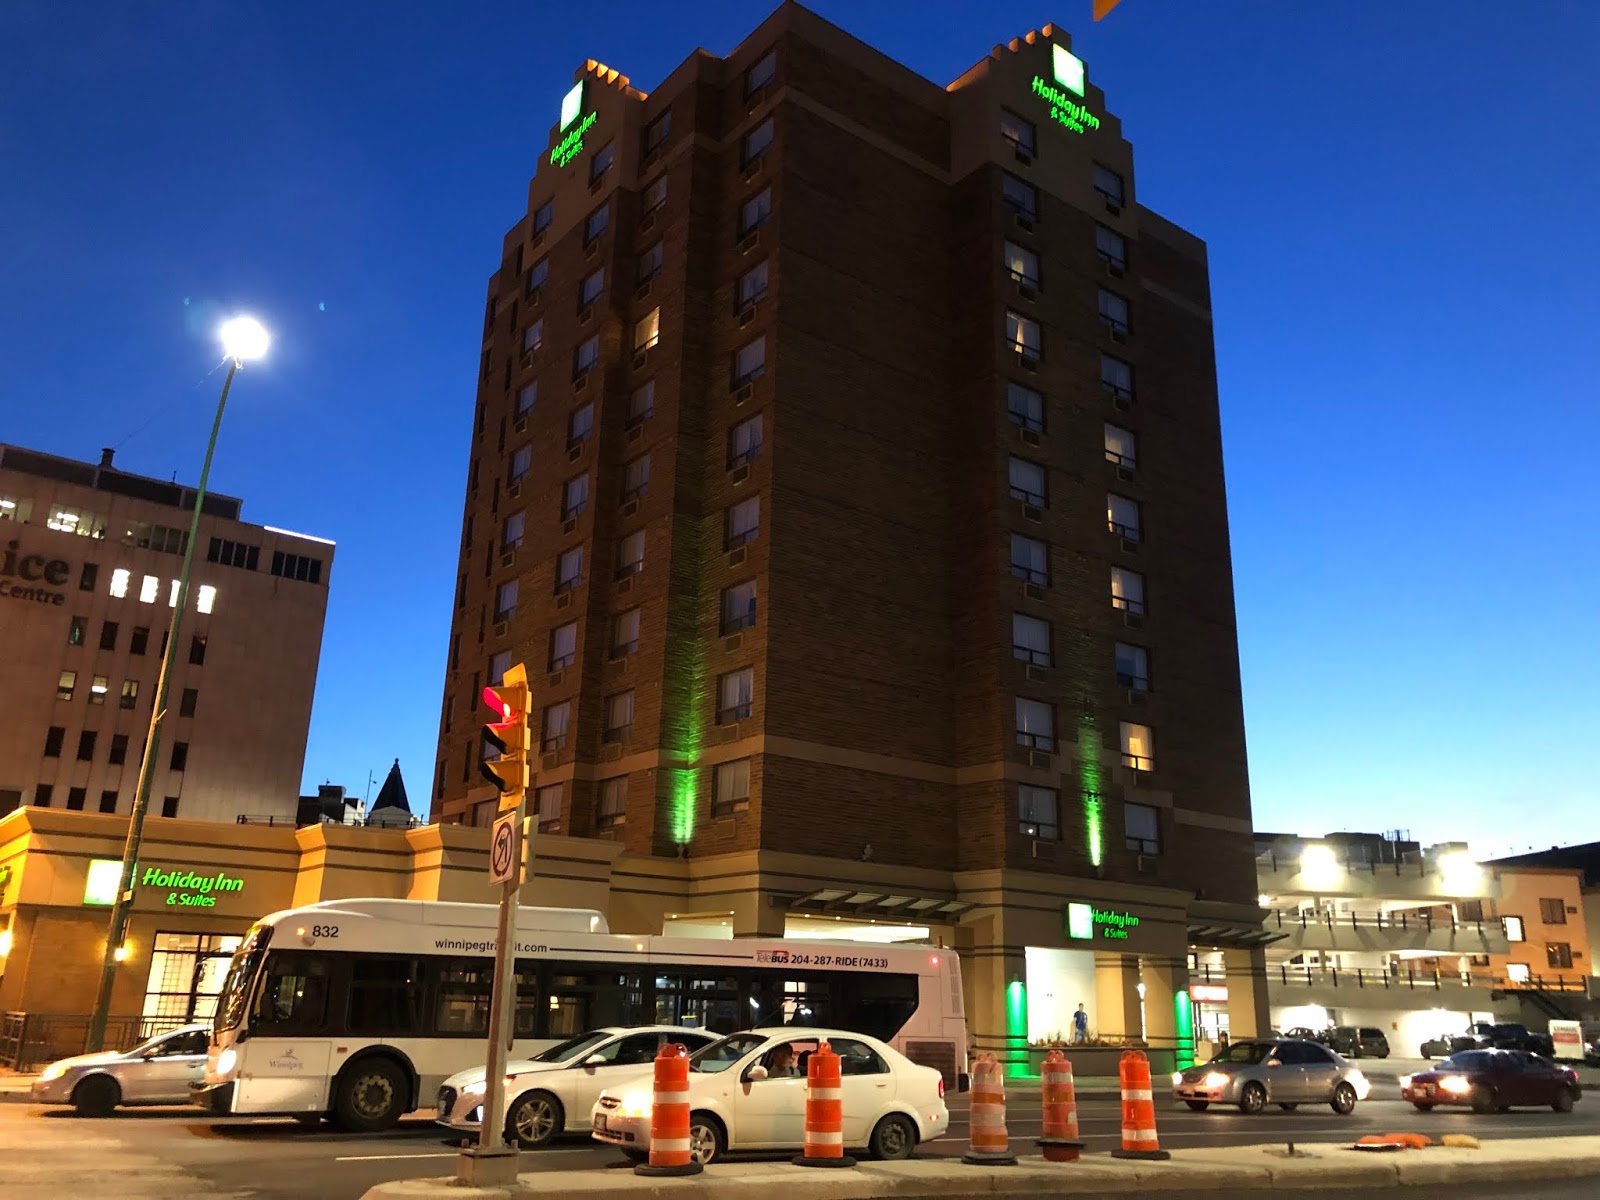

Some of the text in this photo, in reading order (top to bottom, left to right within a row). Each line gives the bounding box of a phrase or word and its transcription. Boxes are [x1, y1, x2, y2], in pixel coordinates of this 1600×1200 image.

[1032, 75, 1100, 131] Holiday Inn
[1050, 106, 1084, 134] & Suites
[550, 111, 597, 165] Holiday Inn
[142, 867, 244, 893] Holiday Inn
[166, 892, 217, 907] & Suites
[1091, 908, 1139, 928] Holiday Inn
[312, 925, 339, 938] 832
[1104, 927, 1129, 939] & Suites
[435, 939, 548, 953] winnipegtrit.com
[756, 950, 889, 968] TeleBUS 204-287-RIDE (7433)
